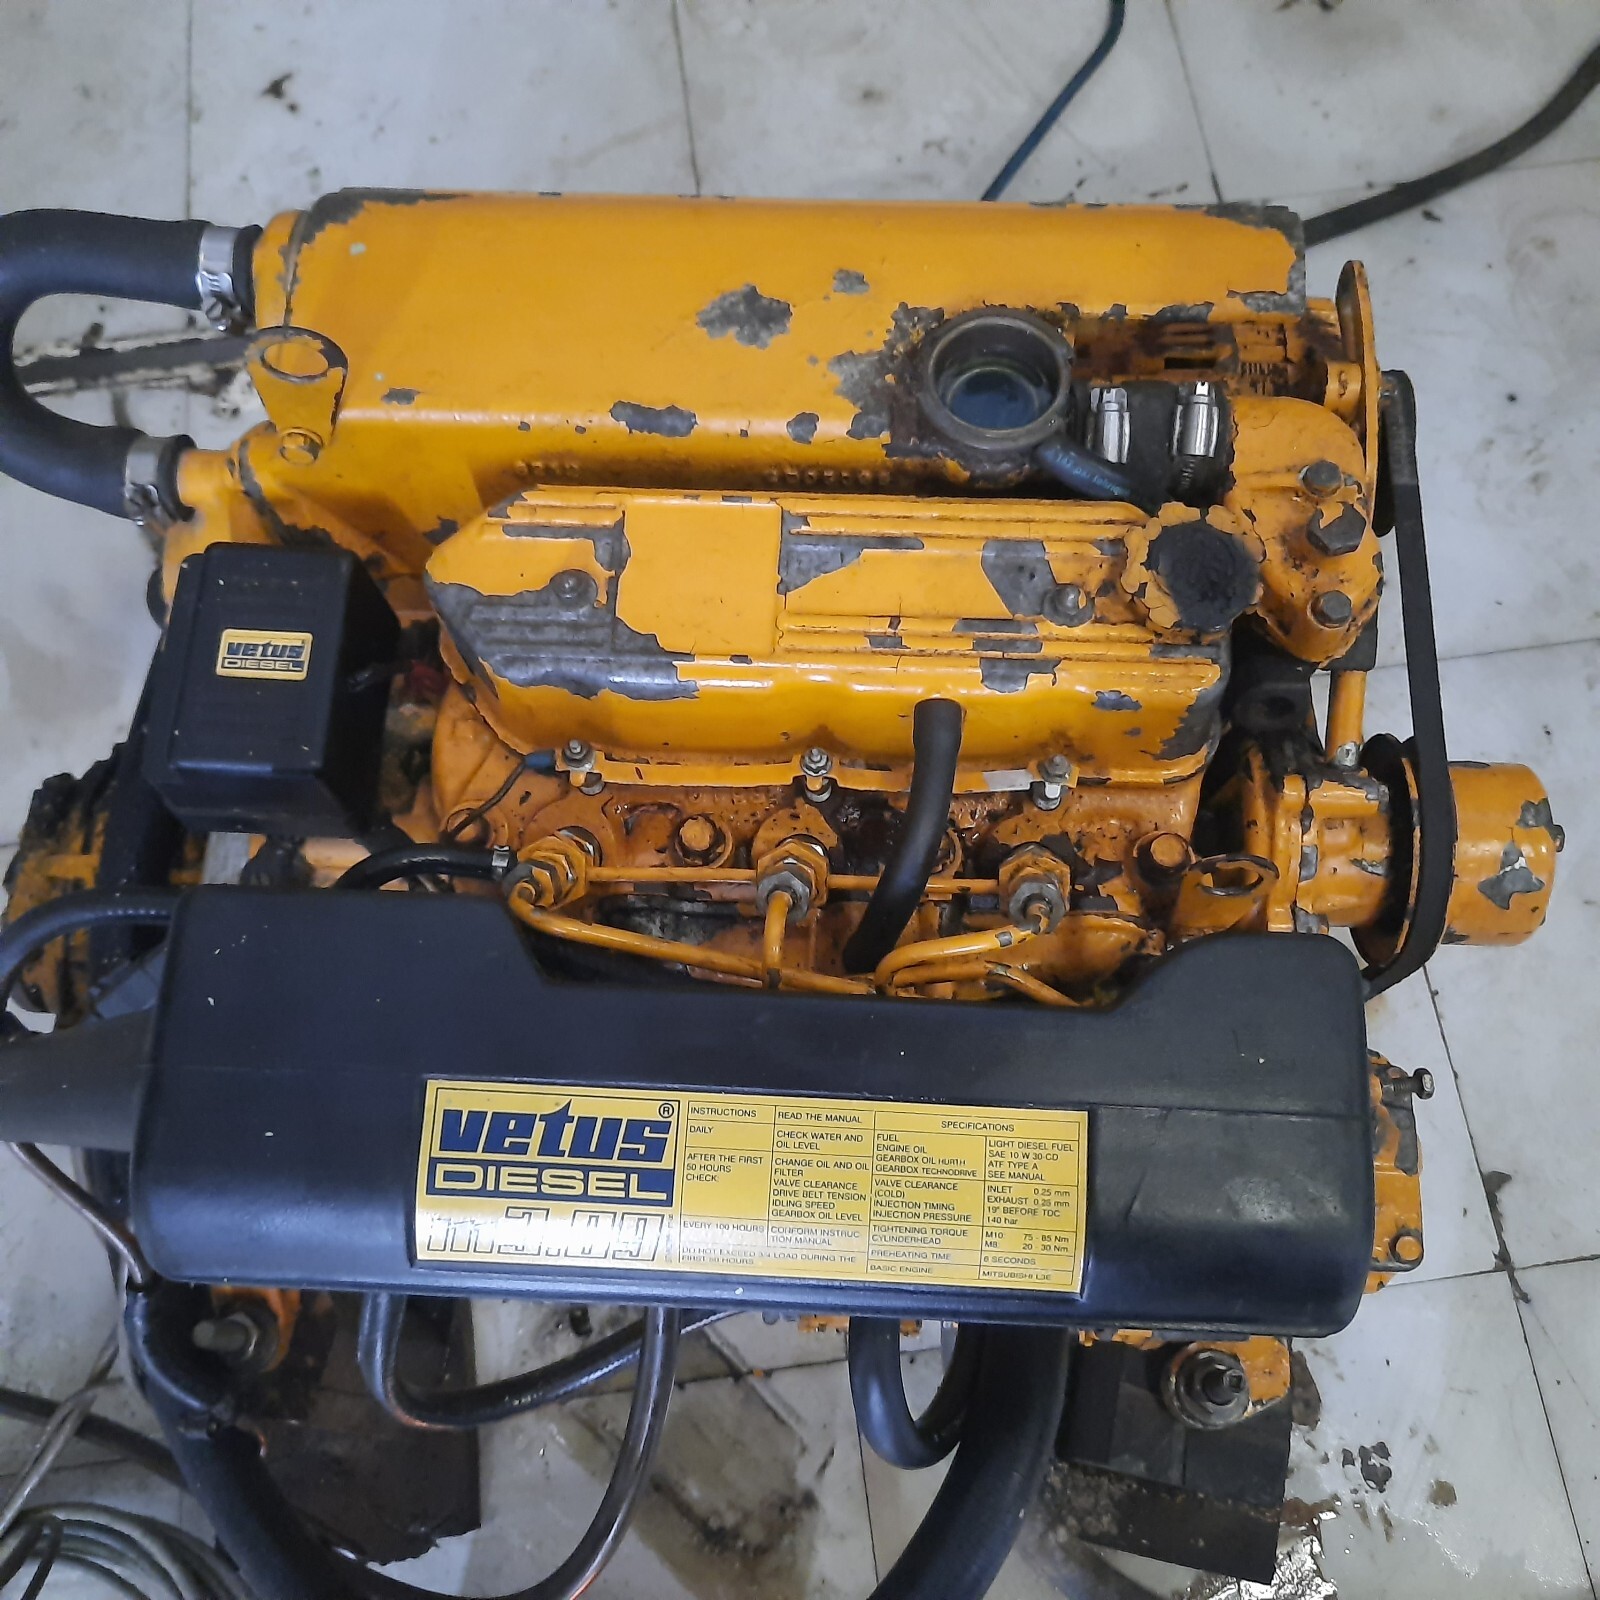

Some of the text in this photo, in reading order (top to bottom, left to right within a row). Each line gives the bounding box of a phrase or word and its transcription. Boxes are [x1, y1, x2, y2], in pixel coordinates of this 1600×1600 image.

[223, 660, 303, 671] DIESEL
[690, 1107, 757, 1118] INSTRUCTIONS
[777, 1111, 862, 1123] READ THE MANUAL
[439, 1099, 672, 1162] vetus
[689, 1125, 714, 1134] DAILY
[941, 1120, 1015, 1132] SPECIFICATIONS
[776, 1130, 864, 1142] CHECK WATER AND
[876, 1133, 899, 1142] FUEL
[776, 1140, 820, 1151] OIL LEVEL
[876, 1144, 927, 1154] ENGINE OIL
[988, 1140, 1074, 1152] LIGHT DIESEL FUEL
[687, 1153, 764, 1165] AFTER THE FIRST
[876, 1154, 919, 1164] GEARBOX
[921, 1156, 936, 1164] OIL
[988, 1150, 1006, 1159] SAE
[1009, 1151, 1019, 1159] 10
[1021, 1152, 1031, 1160] W
[686, 1163, 732, 1173] 50 HOURS
[774, 1157, 869, 1171] CHANGE OIL AND OIL
[987, 1161, 1005, 1169] ATF
[1008, 1161, 1029, 1170] TYPE
[774, 1168, 804, 1177] FILTER
[875, 1164, 977, 1177] GEARBOX TECHNODRIVE
[987, 1170, 1045, 1181] SEE MANUAL
[434, 1162, 668, 1201] DIESEL
[773, 1179, 858, 1191] VALVE CLEARANCE
[874, 1179, 958, 1191] VALVE CLEARANCE
[772, 1189, 867, 1201] DRIVE BELT TENSION
[874, 1190, 905, 1199] (COLD)
[987, 1185, 1013, 1194] INLET
[772, 1199, 835, 1210] IDLING SPEED
[873, 1200, 955, 1211] INJECTION TIMING
[987, 1196, 1028, 1205] EXHAUST
[771, 1209, 863, 1222] GEARBOX OIL LEVEL
[873, 1210, 972, 1222] INJECTION PRESSURE
[1002, 1207, 1038, 1216] BEFORE
[1042, 1209, 1061, 1217] TDC
[987, 1216, 1002, 1224] 140
[683, 1220, 712, 1229] EVERY
[732, 1223, 764, 1233] HOURS
[771, 1225, 818, 1236] CONFORM
[872, 1224, 968, 1237] TIGHTENING TORQUE
[794, 1237, 832, 1246] MANUAL
[871, 1235, 941, 1245] CYLINDERHEAD
[1054, 1235, 1069, 1243] Nm
[871, 1250, 928, 1260] PREHEATING
[991, 1257, 1036, 1265] SECONDS
